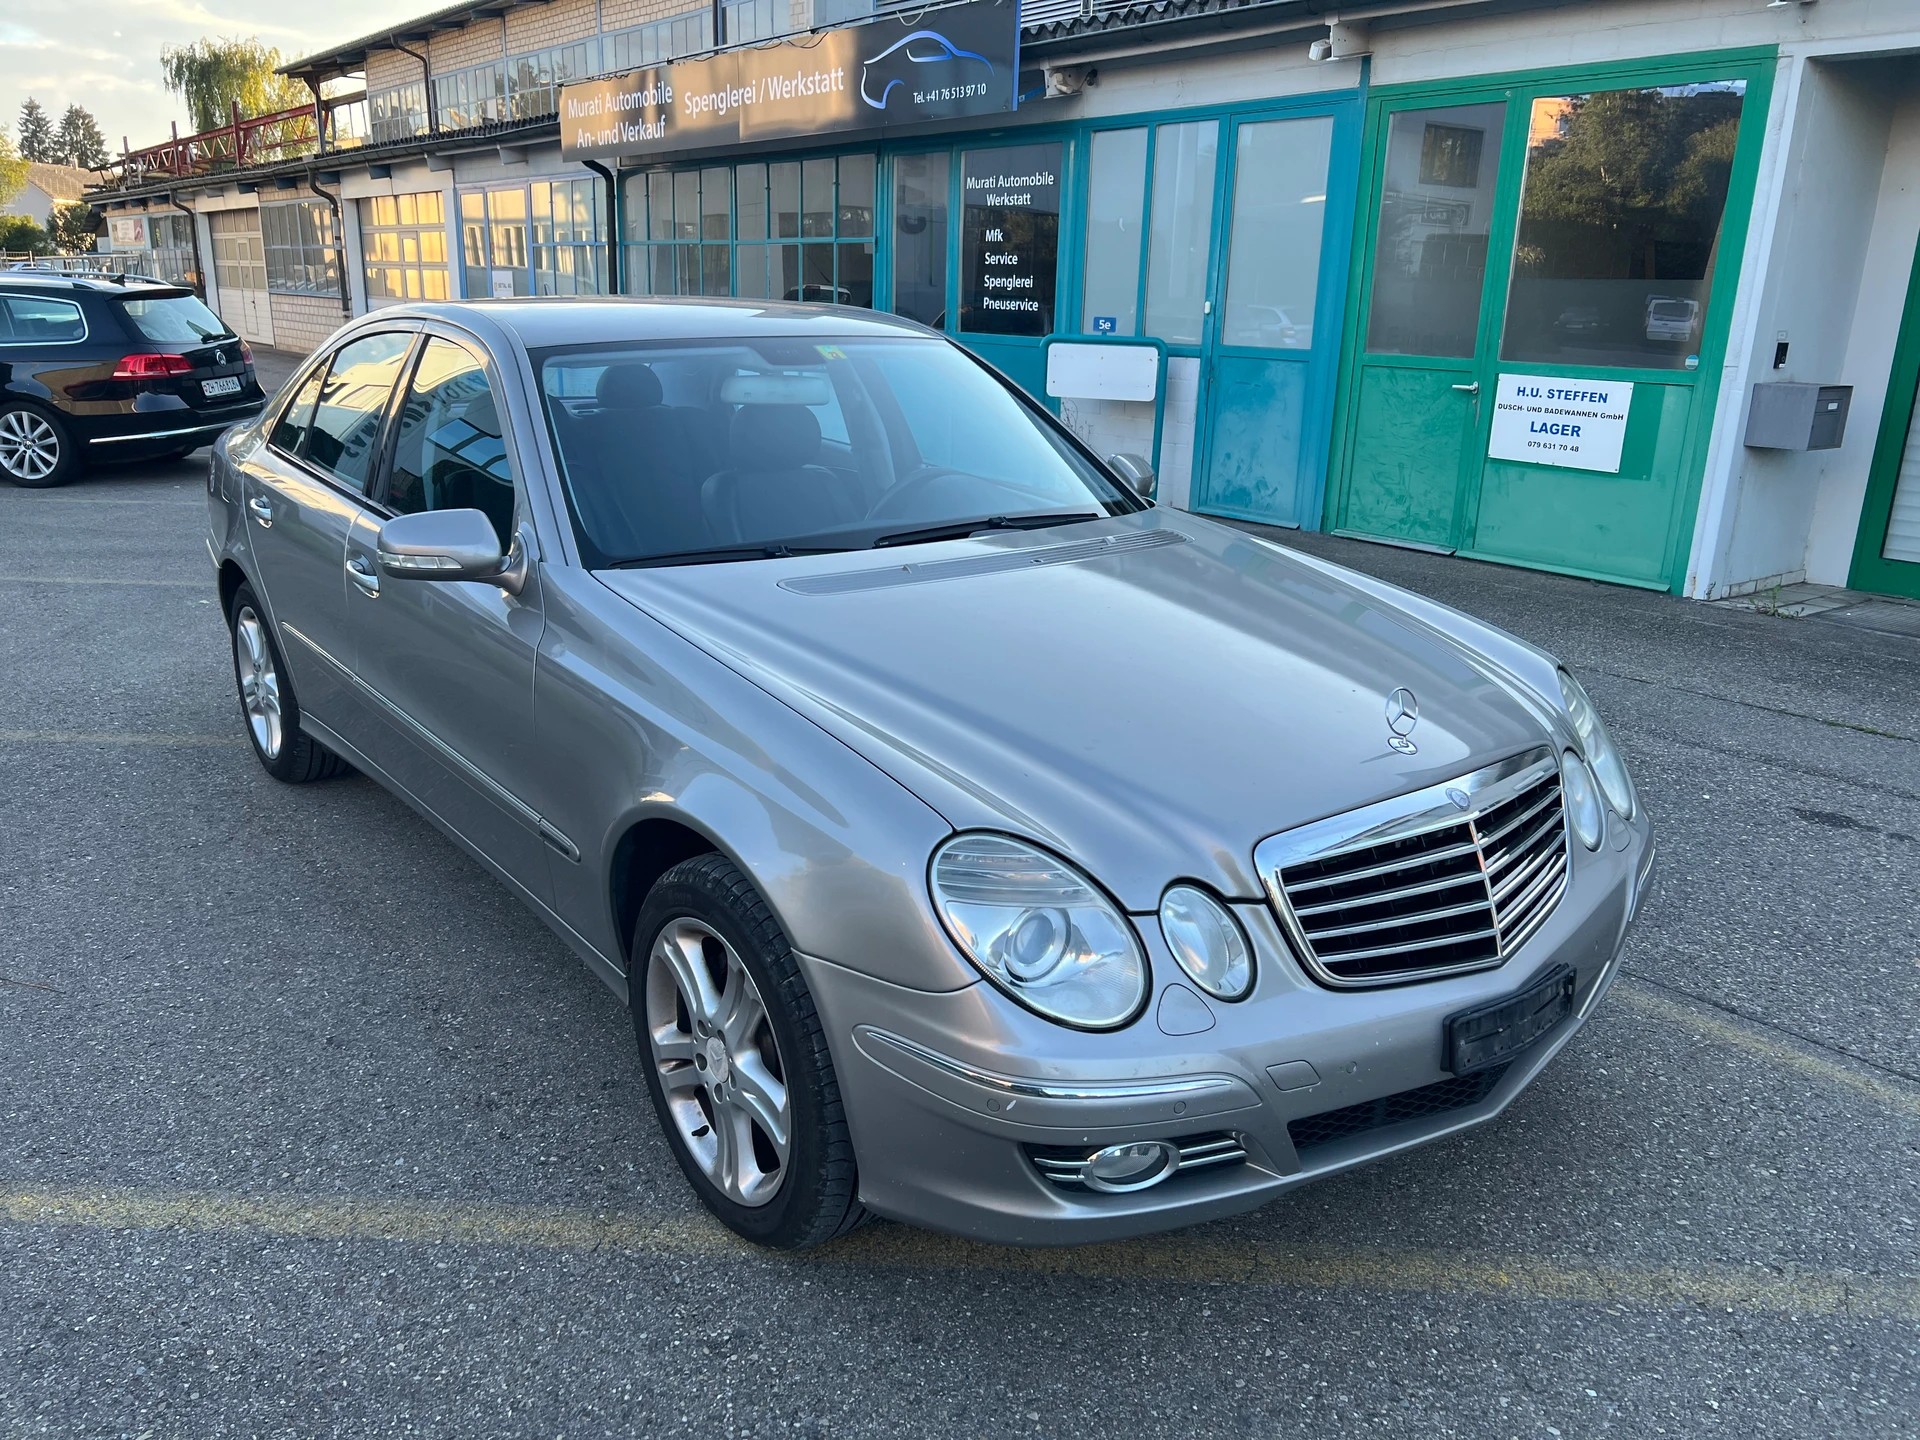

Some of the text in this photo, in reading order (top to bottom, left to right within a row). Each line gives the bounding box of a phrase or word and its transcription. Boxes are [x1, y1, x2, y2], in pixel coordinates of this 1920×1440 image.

[568, 80, 673, 119] Murati Automobile
[684, 66, 844, 119] Spenglerei / Werkstatt
[913, 82, 987, 104] Tel. +41 76 513 97 10
[577, 114, 666, 149] An- und Verkauf
[966, 171, 1055, 190] Murati Automobile
[986, 193, 1031, 207] Werkstatt
[985, 228, 1004, 242] Mfk
[984, 252, 1018, 265] Service
[983, 274, 1034, 291] Spenglerei
[983, 297, 1039, 311] Pneuservice
[1098, 319, 1111, 330] 5e
[1516, 386, 1608, 403] H.U. STEFFEN
[1497, 403, 1525, 411] DUSCH-
[1544, 407, 1598, 418] BADEWANNEN
[1600, 412, 1624, 421] GmbH
[1530, 421, 1581, 437] LAGER
[1527, 440, 1541, 448] 079
[1542, 442, 1556, 450] 631
